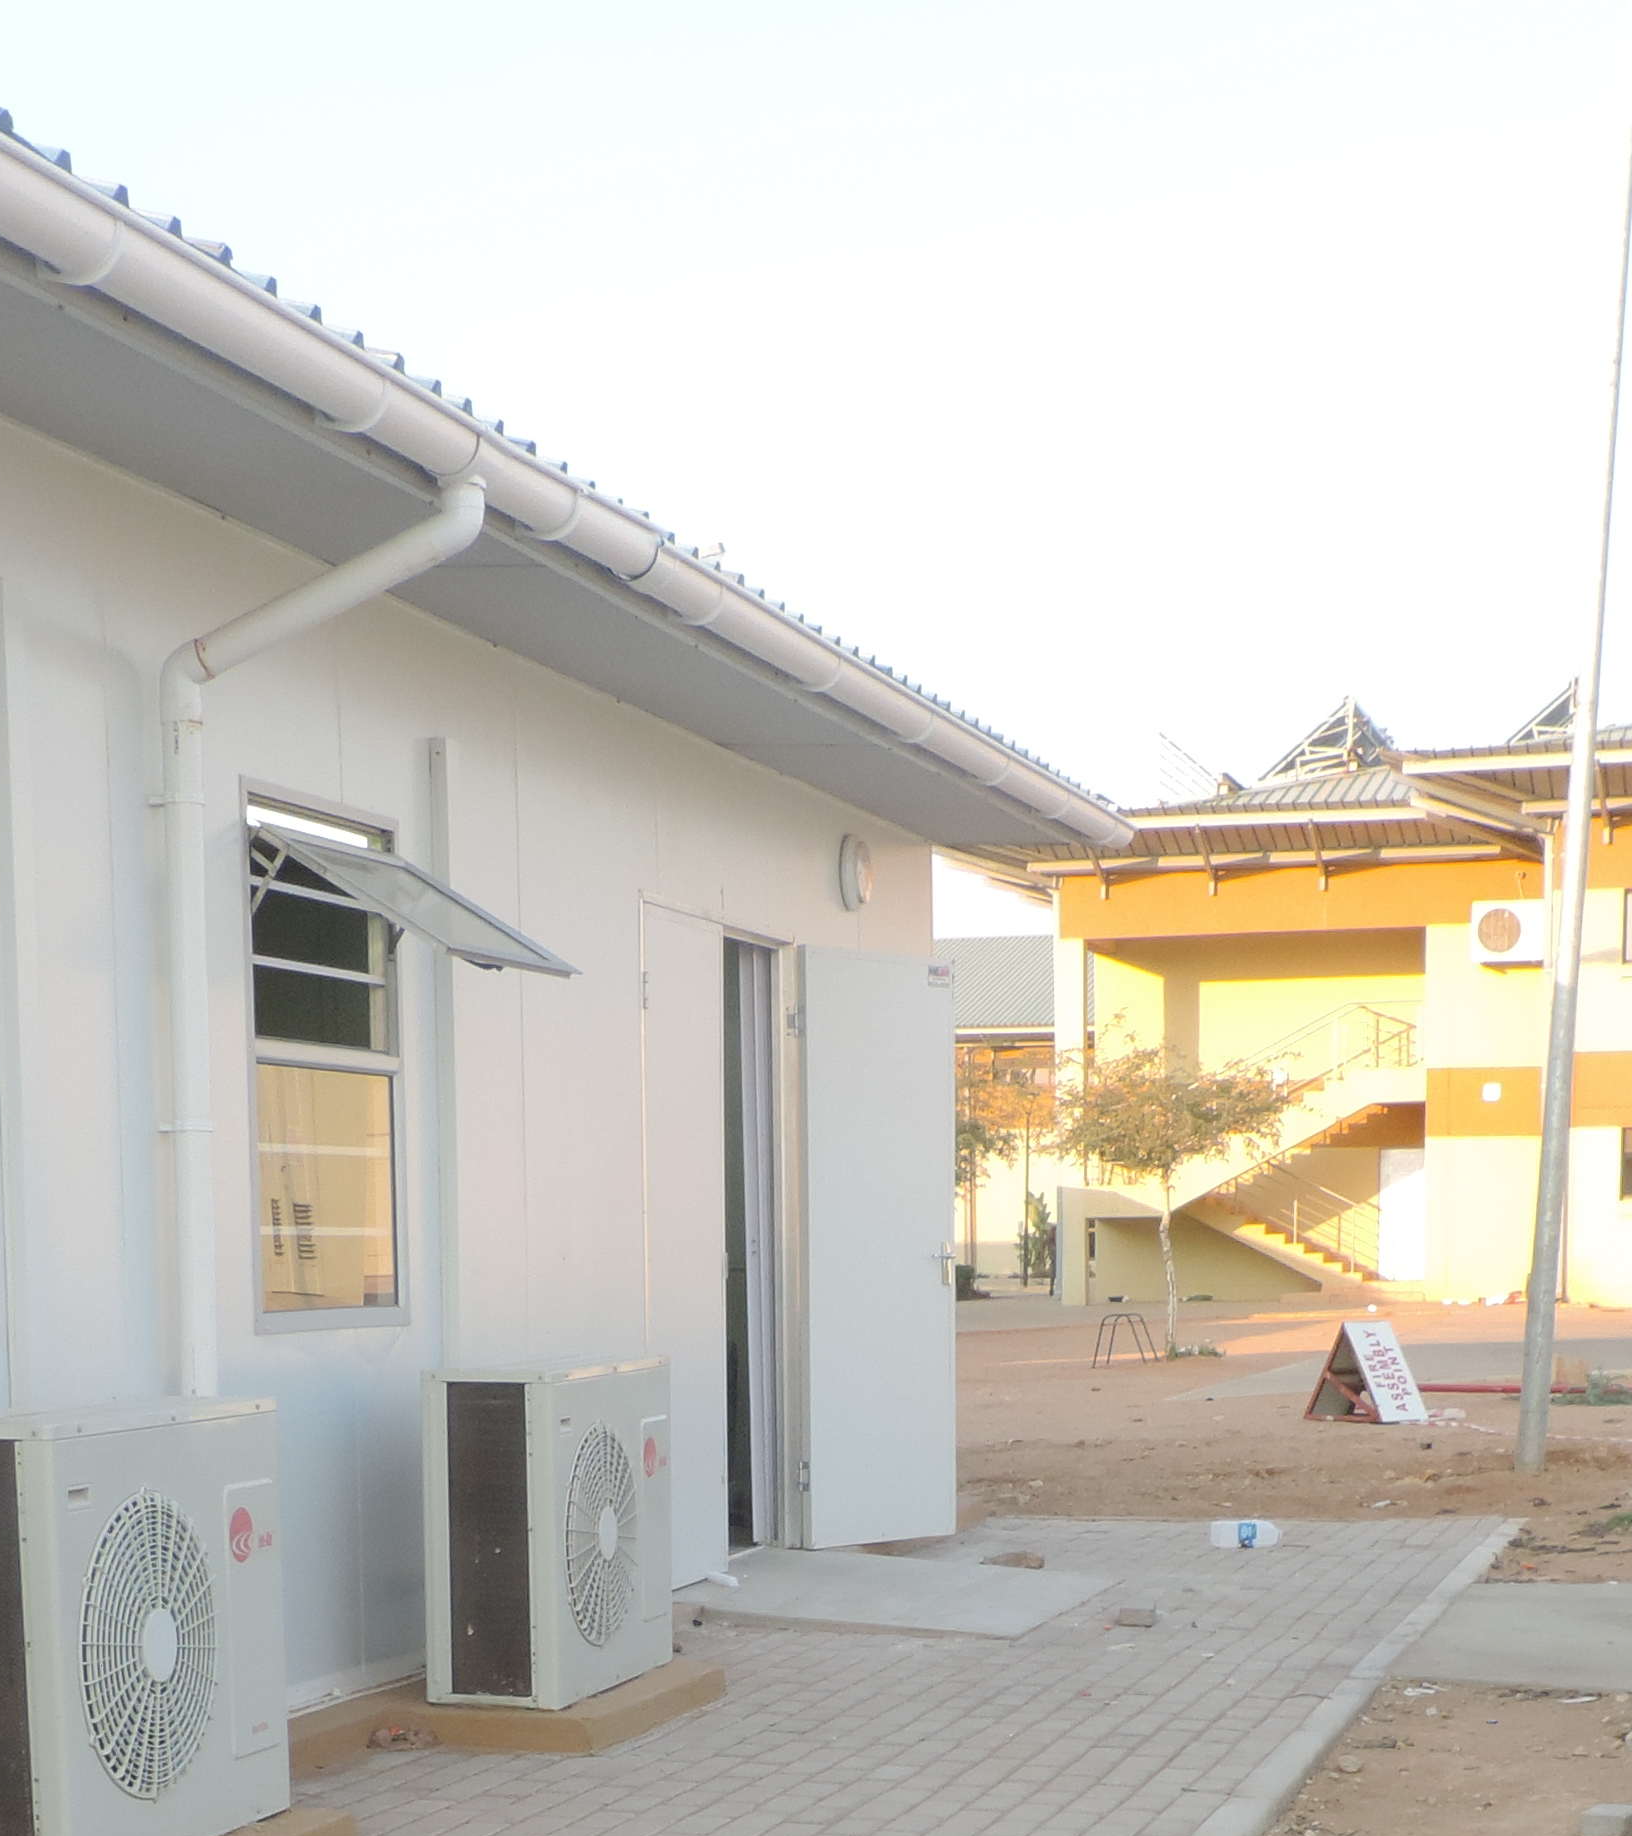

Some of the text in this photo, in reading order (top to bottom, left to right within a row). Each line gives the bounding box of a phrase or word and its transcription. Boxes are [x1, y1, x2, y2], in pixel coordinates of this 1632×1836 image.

[1363, 1353, 1386, 1388] FIRE
[1363, 1329, 1409, 1412] ASSEMBLY
[1383, 1346, 1412, 1396] POINT
